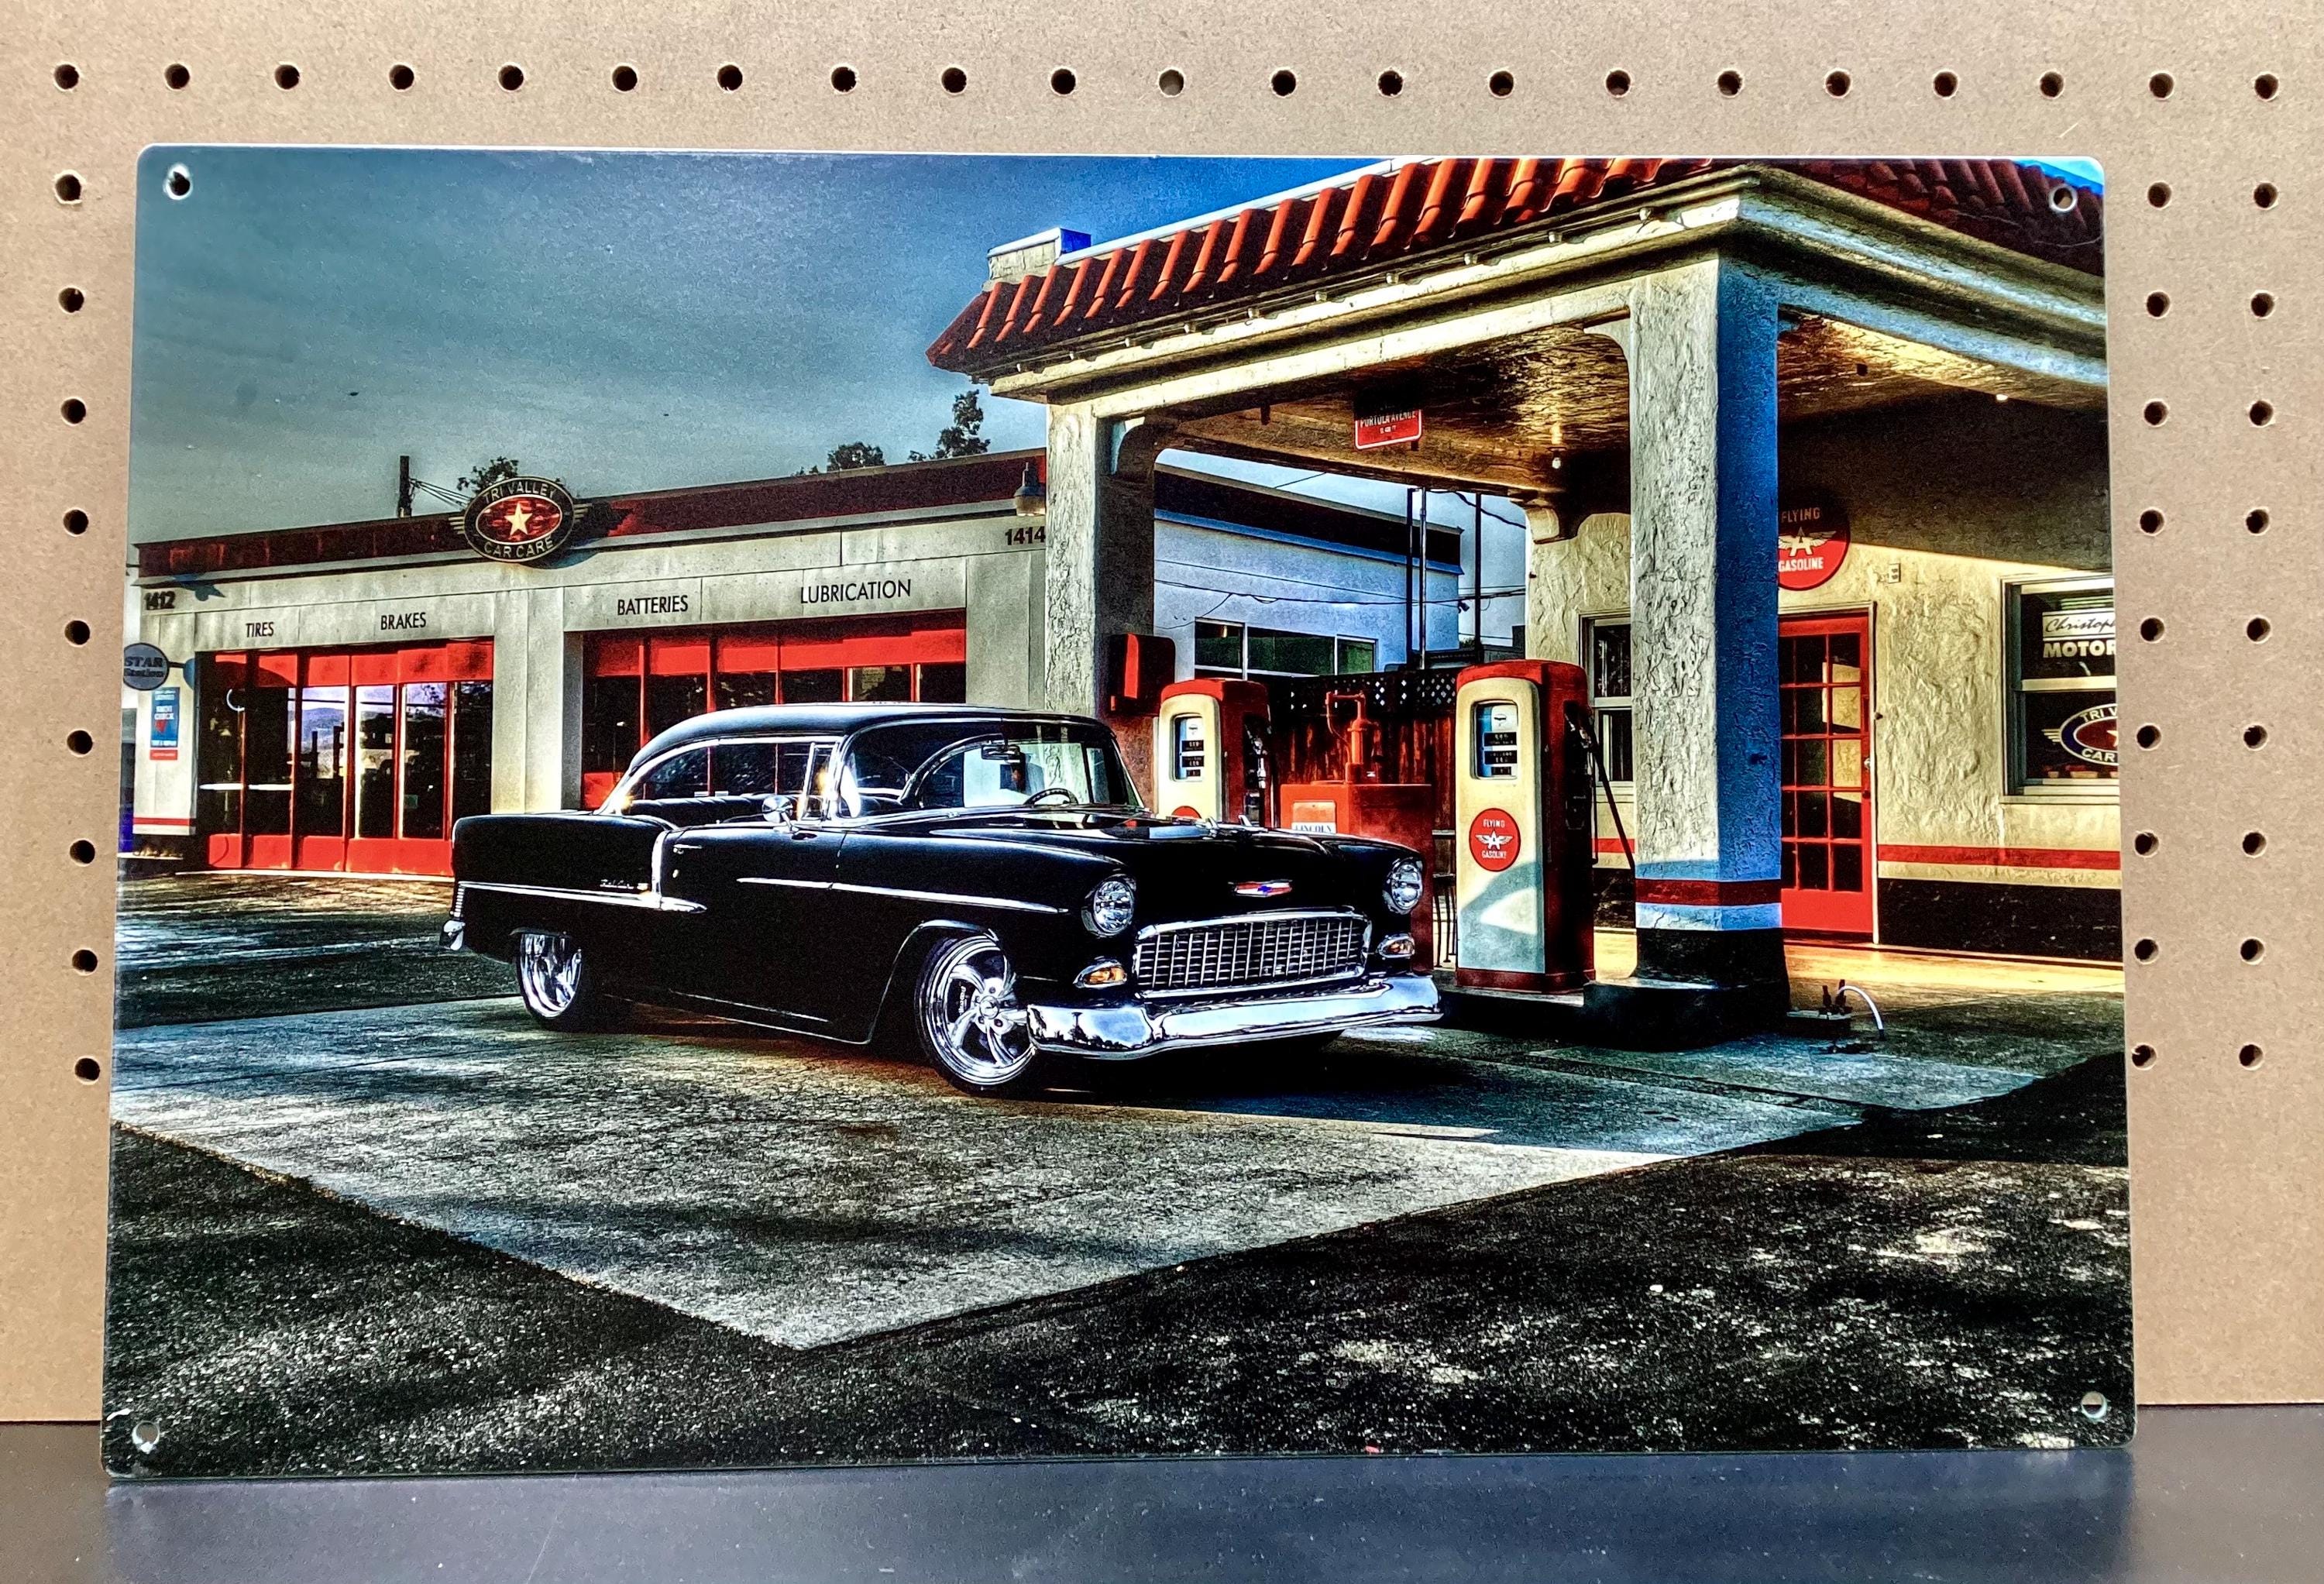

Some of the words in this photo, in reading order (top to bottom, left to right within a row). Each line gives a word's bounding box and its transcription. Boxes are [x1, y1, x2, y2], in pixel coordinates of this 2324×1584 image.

[483, 488, 504, 503] TRI
[507, 481, 557, 499] VALLEY
[1781, 507, 1820, 524] FLYING
[1005, 525, 1046, 545] 1414
[483, 541, 511, 558] CAR
[516, 535, 554, 558] CARE
[1779, 557, 1824, 572] GASOLINE
[143, 590, 176, 610] 1412
[800, 579, 912, 604] LUBRICATION
[617, 595, 689, 616] BATTERIES
[246, 621, 274, 637] TIRES
[380, 611, 427, 630] BRAKES
[125, 656, 163, 668] STAR
[2080, 708, 2105, 723] TRI
[2082, 747, 2115, 762] CAR
[1483, 819, 1505, 828] FLYING
